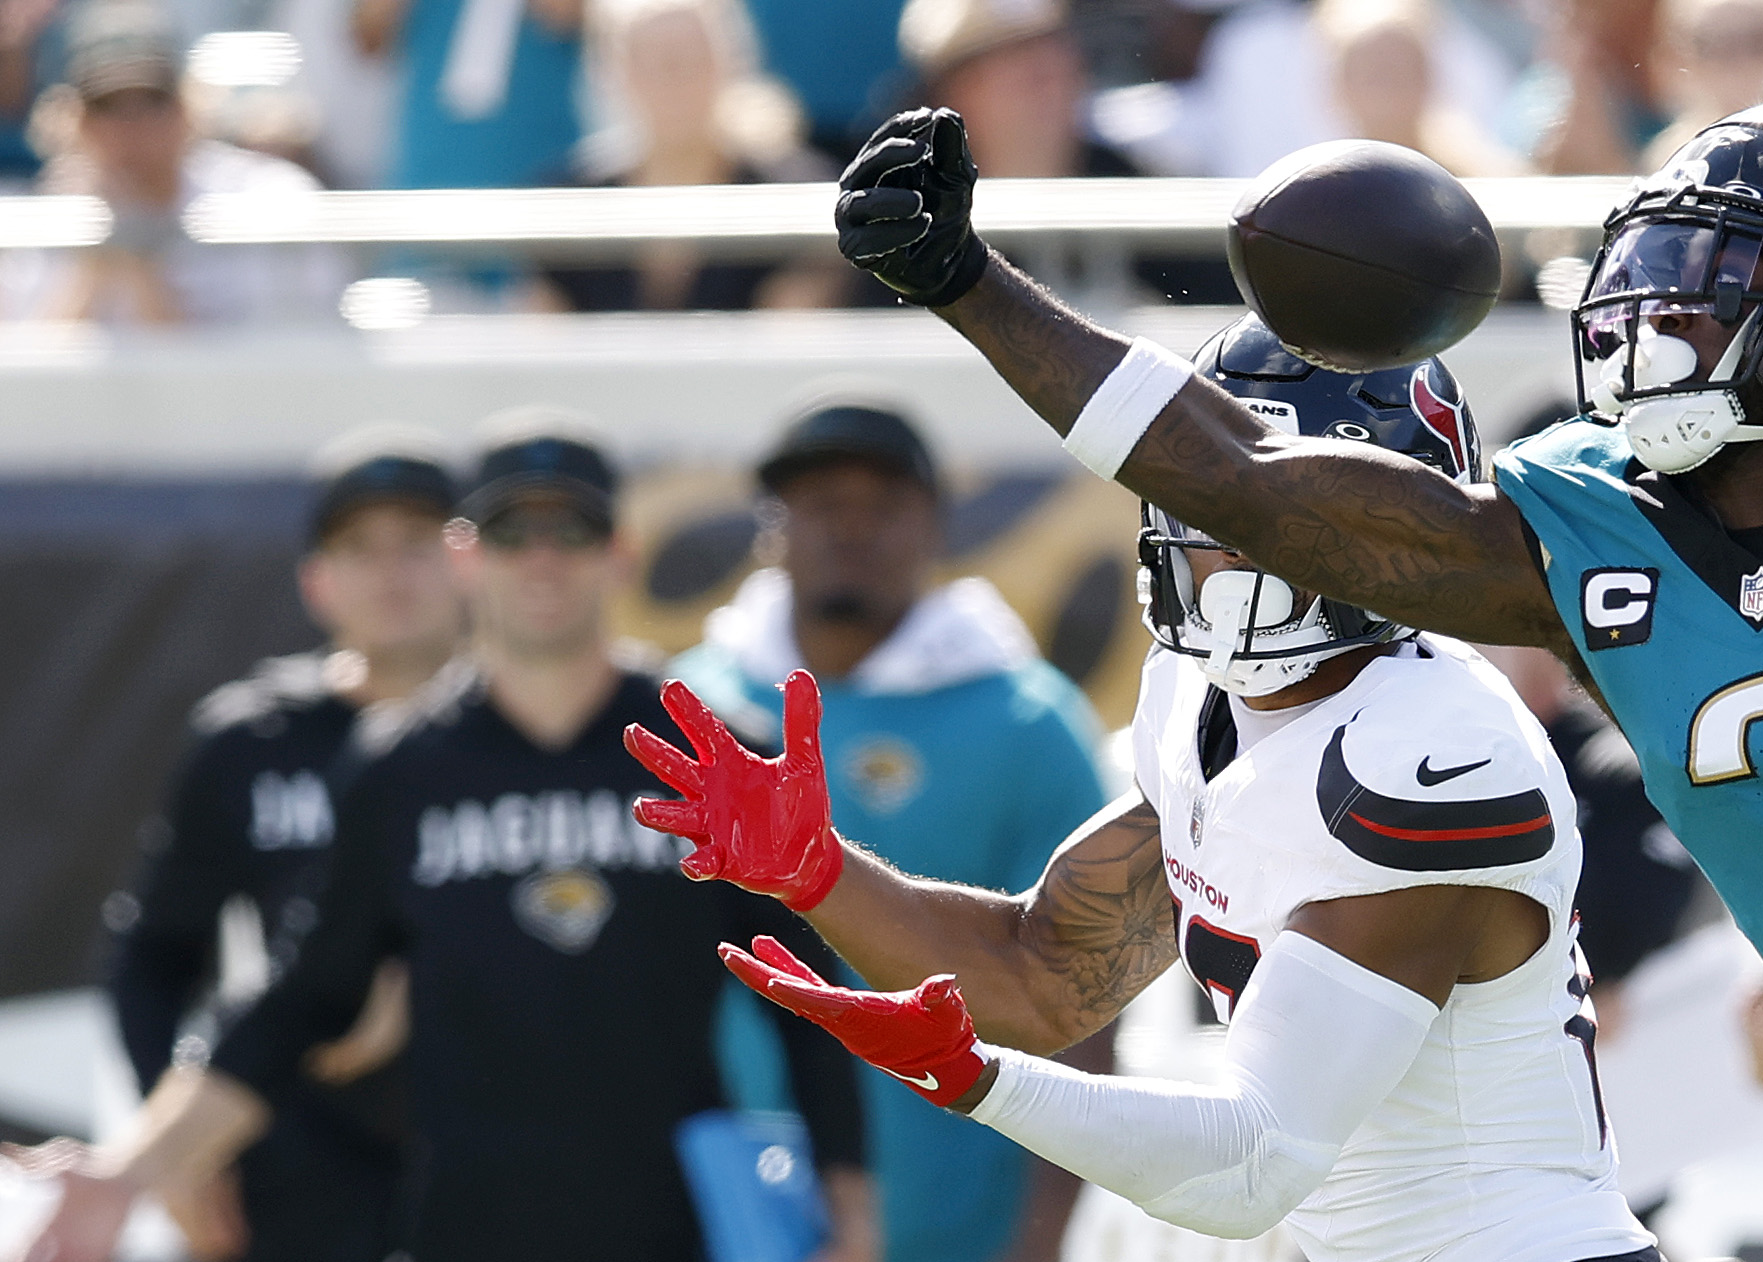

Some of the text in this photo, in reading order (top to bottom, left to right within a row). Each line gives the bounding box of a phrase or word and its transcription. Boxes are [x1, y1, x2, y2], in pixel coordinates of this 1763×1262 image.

[1247, 403, 1289, 417] ANS
[1584, 572, 1652, 629] C
[1164, 848, 1229, 915] HOUSTON
